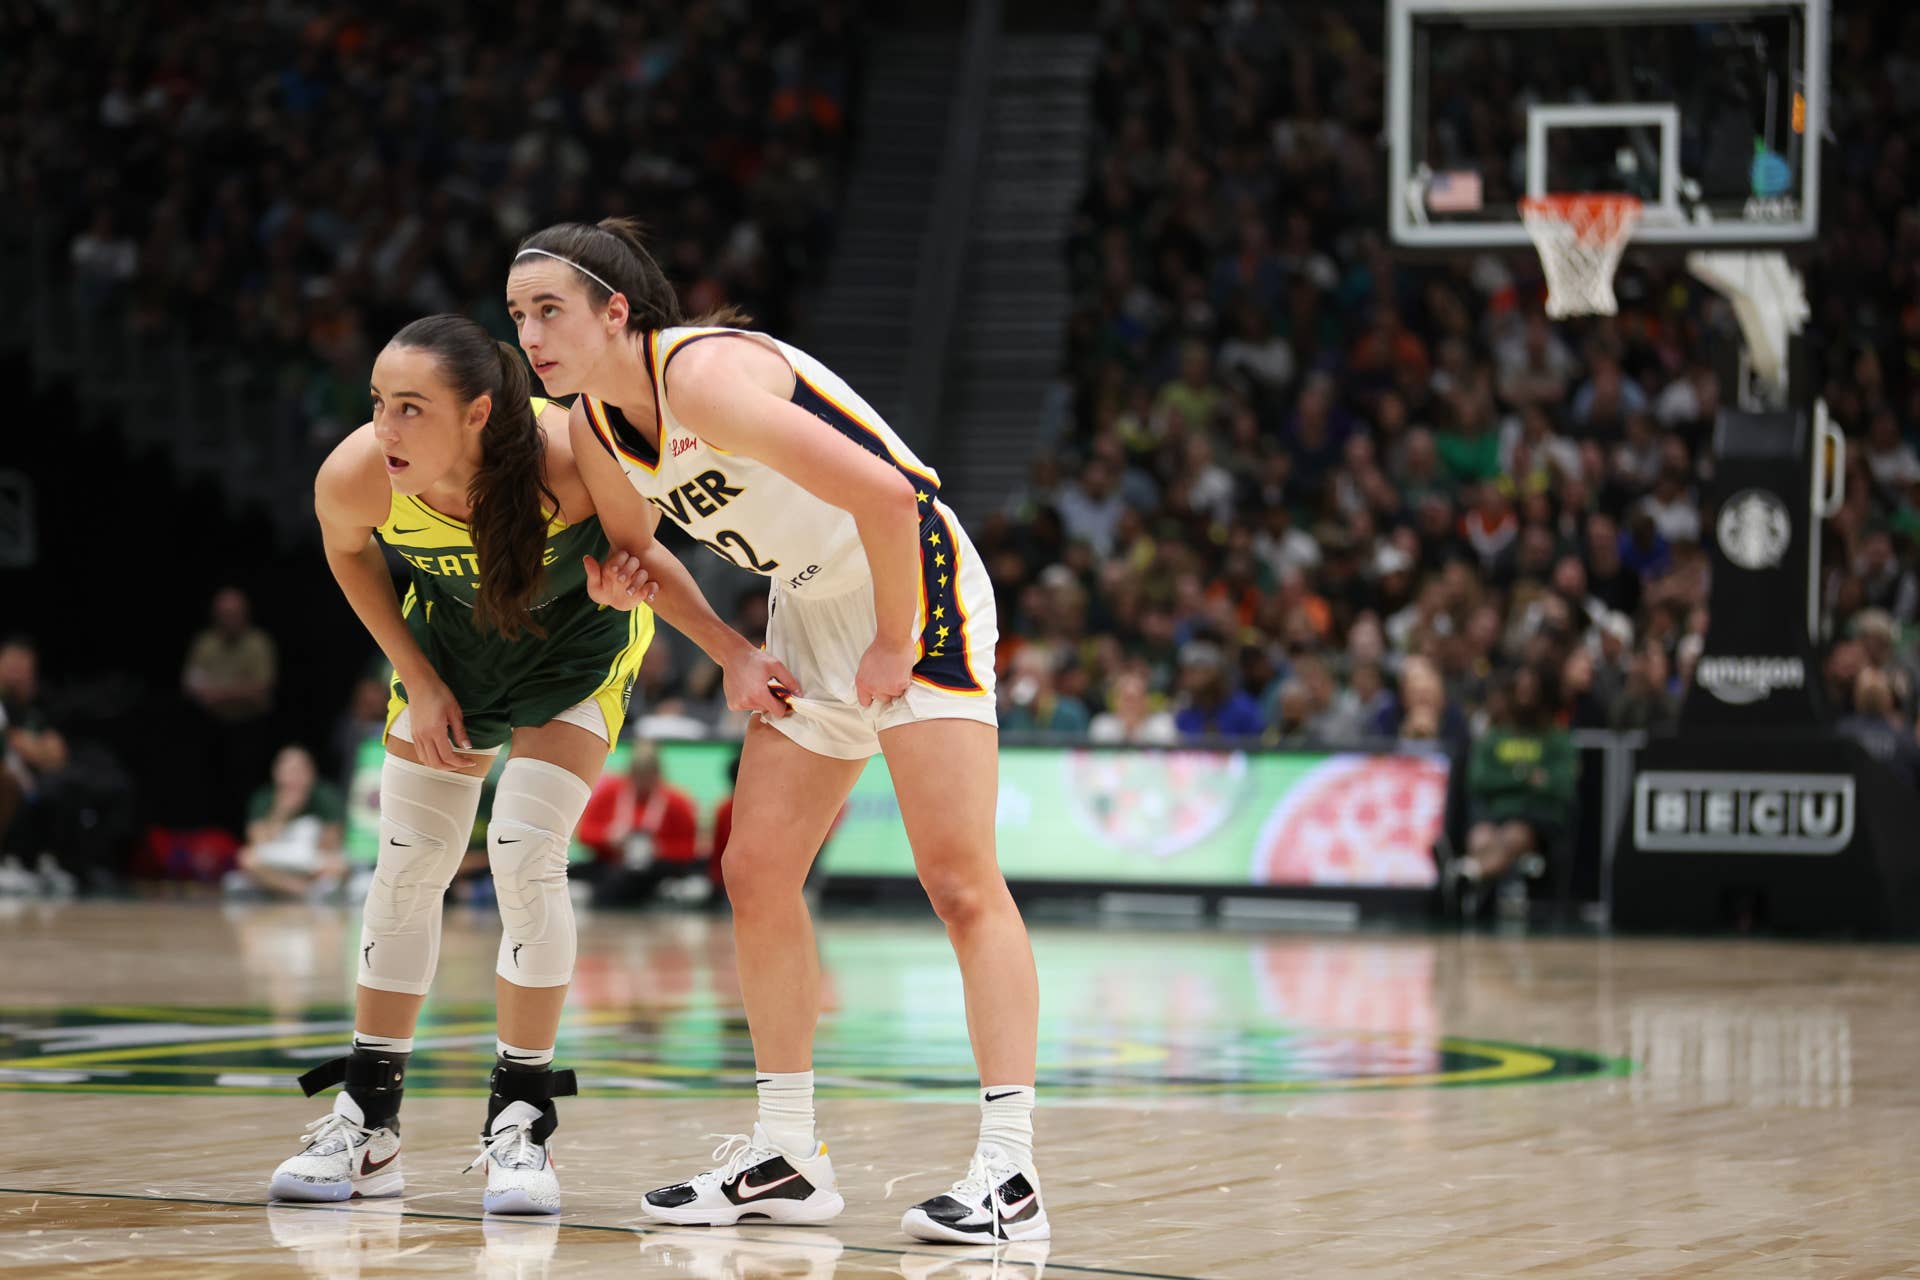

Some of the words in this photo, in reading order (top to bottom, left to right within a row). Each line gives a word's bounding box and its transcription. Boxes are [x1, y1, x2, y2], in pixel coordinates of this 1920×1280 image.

[671, 436, 698, 458] Lilly
[397, 546, 559, 577] SEATE
[1695, 656, 1805, 689] amazon
[1653, 791, 1839, 838] BECU
